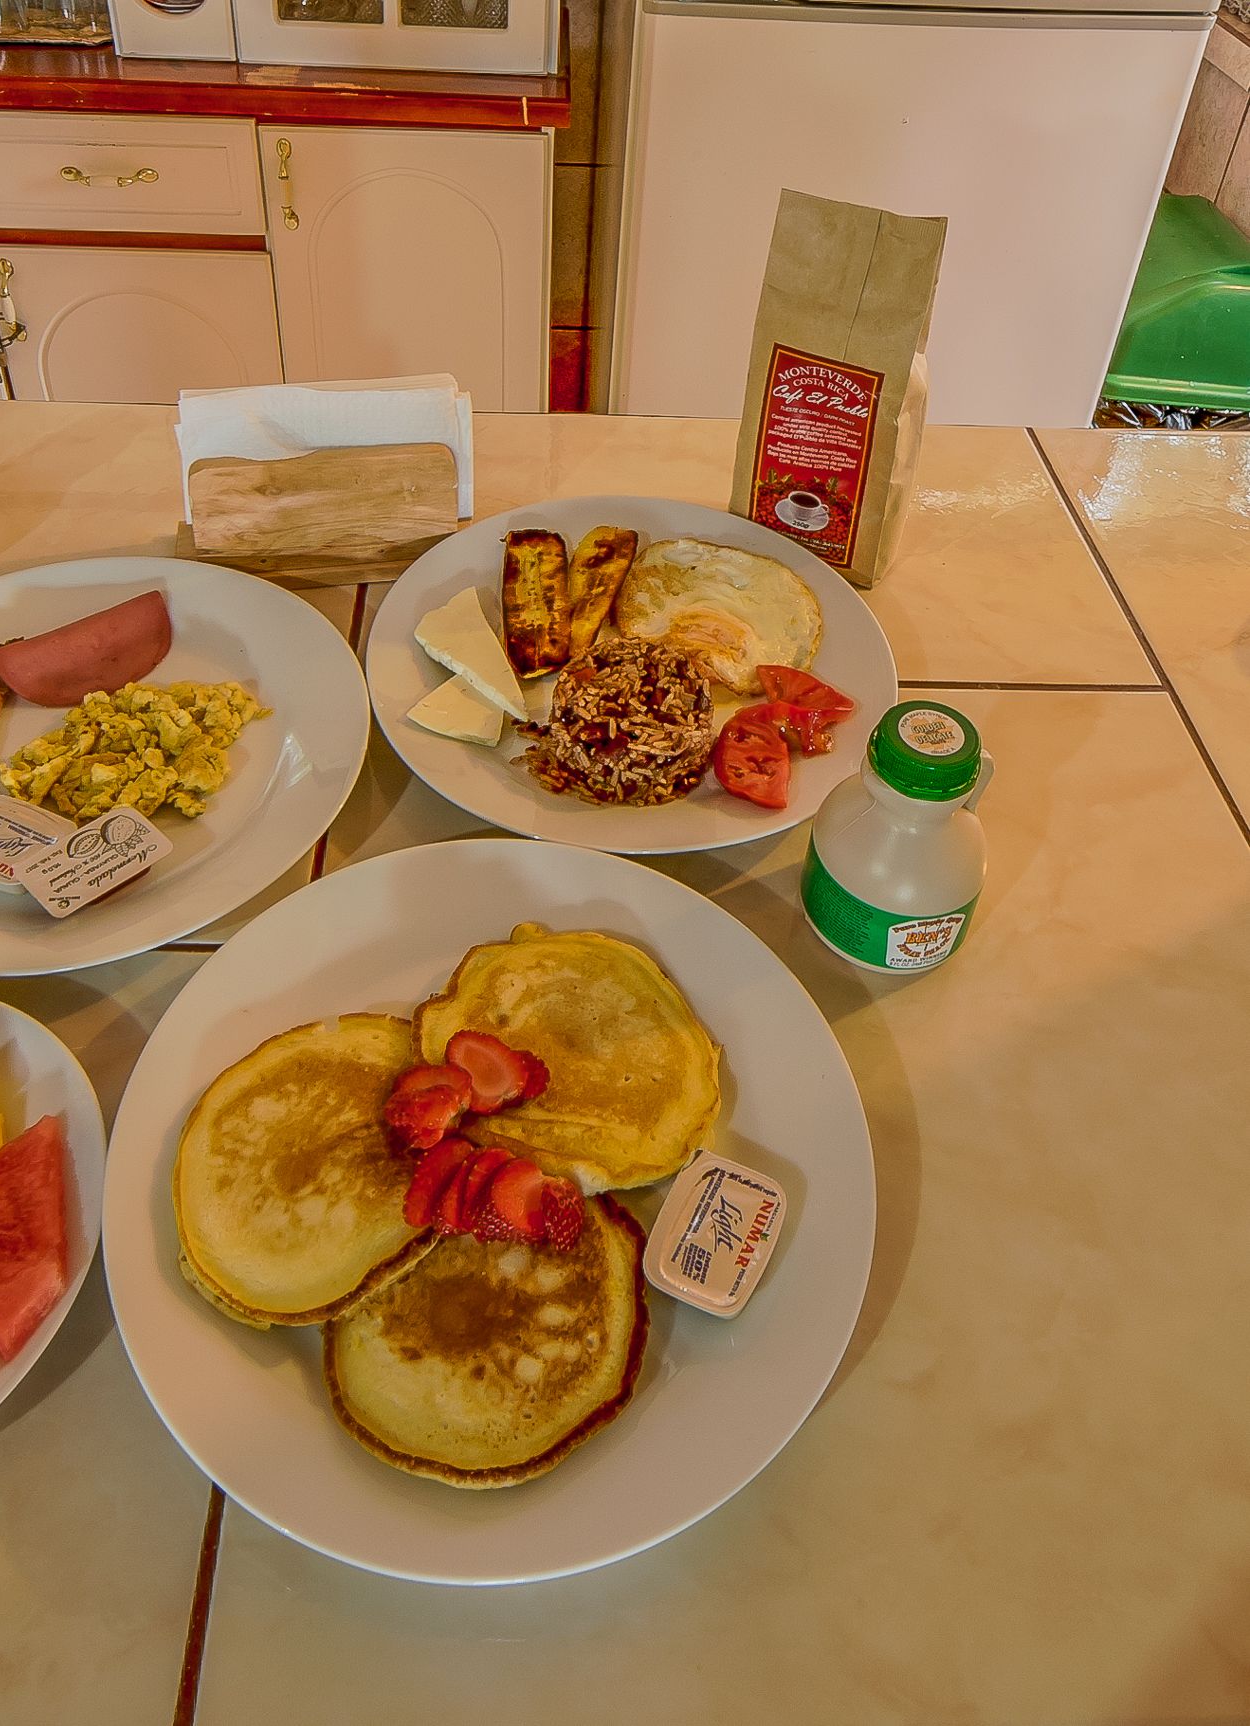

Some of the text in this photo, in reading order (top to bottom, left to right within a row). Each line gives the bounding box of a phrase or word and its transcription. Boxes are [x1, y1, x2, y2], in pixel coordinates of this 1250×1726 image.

[777, 366, 867, 403] MONTEVERDE
[792, 377, 849, 400] COSTA RICA
[806, 392, 823, 405] El
[827, 396, 869, 418] Pueblo
[84, 854, 119, 875] GUAYABA
[87, 844, 158, 887] Mermelada
[904, 925, 953, 944] BEN'S
[710, 1194, 744, 1253] Light
[734, 1199, 775, 1268] NUMAR
